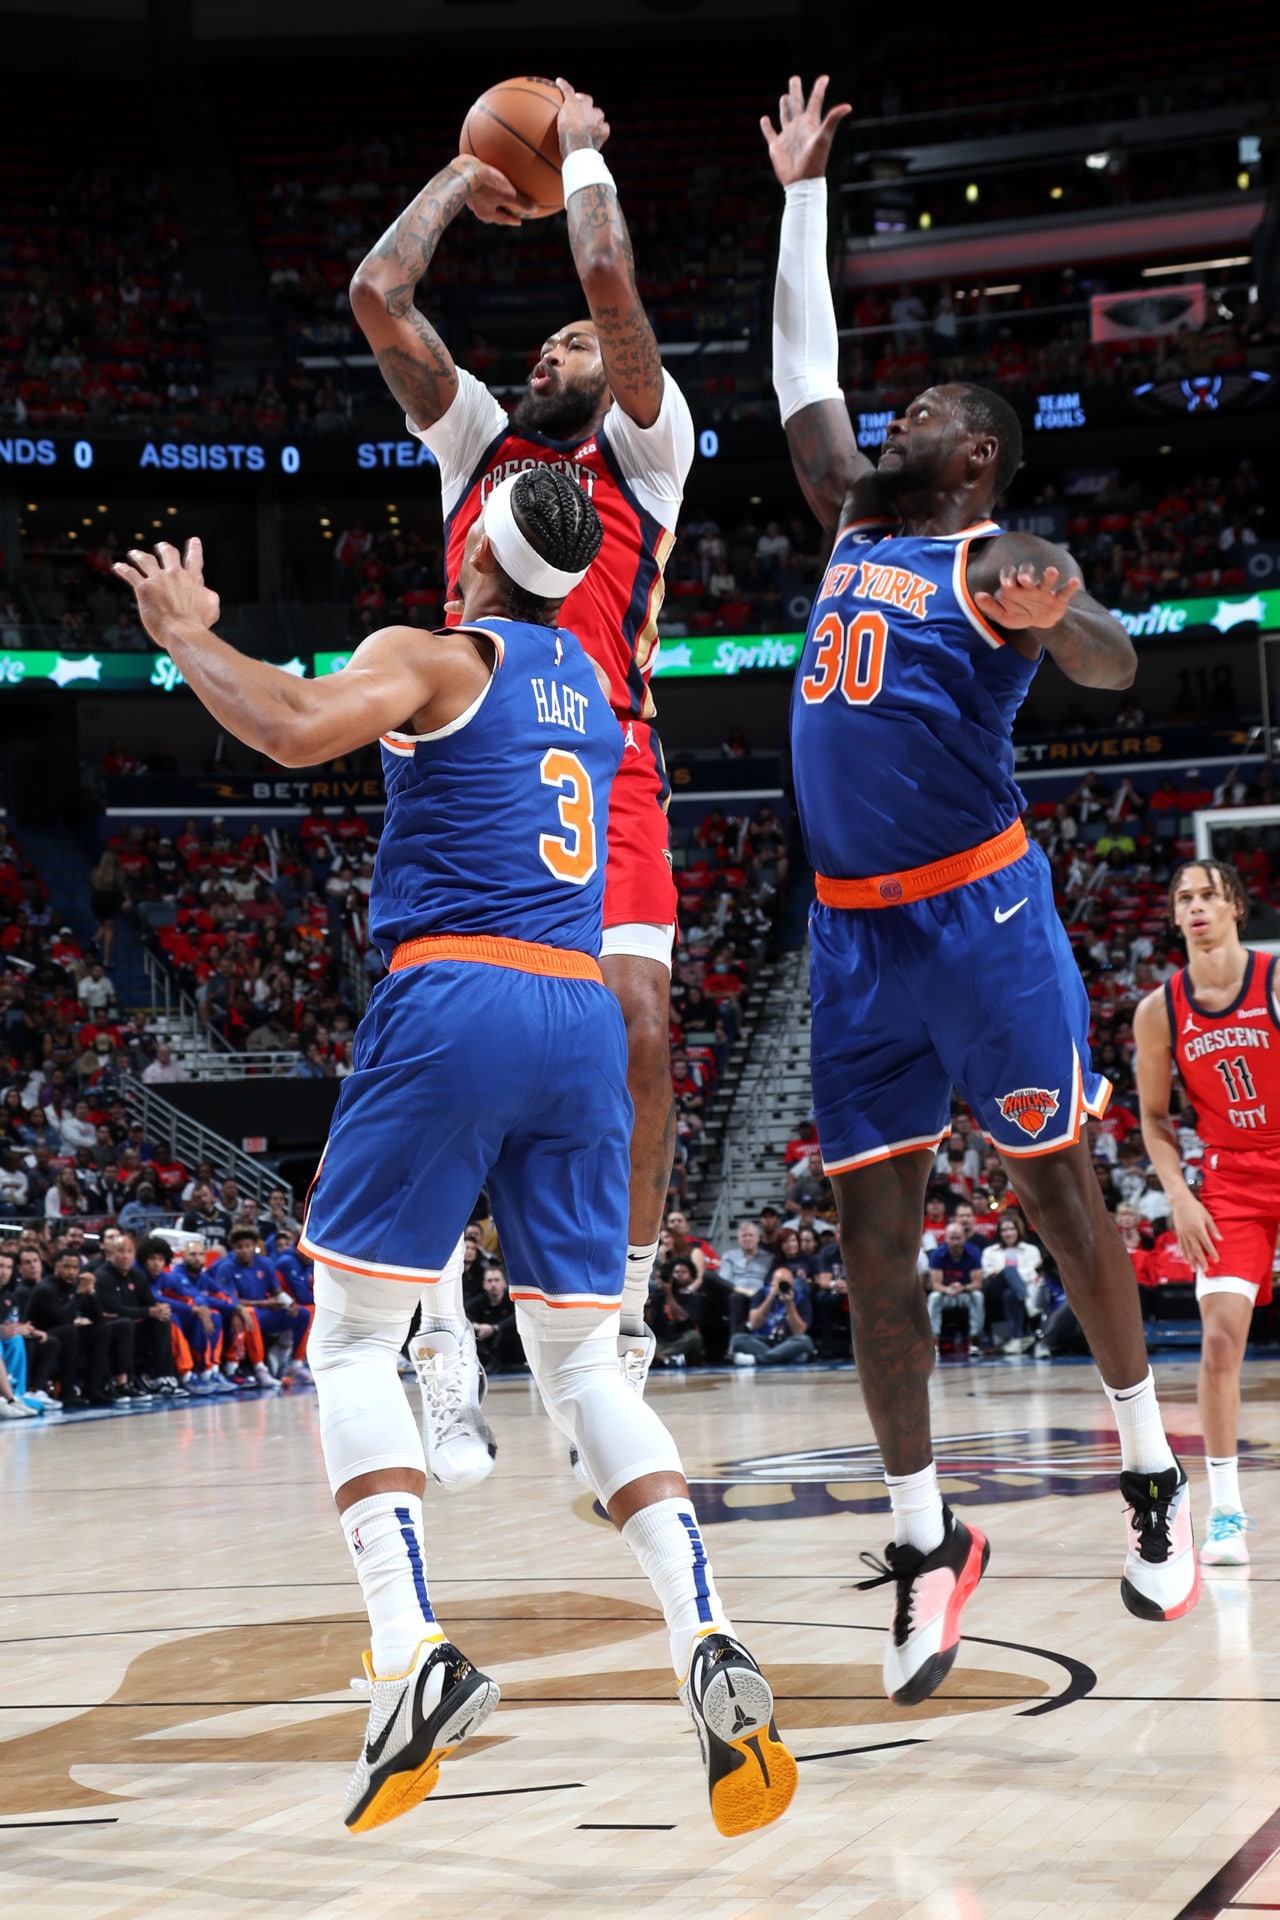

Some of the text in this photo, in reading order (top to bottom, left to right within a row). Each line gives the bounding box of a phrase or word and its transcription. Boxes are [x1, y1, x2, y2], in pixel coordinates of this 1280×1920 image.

[1034, 408, 1086, 431] FOULS
[1037, 392, 1080, 409] TEAM
[74, 441, 93, 469] 0
[139, 442, 266, 471] ASSISTS
[281, 446, 300, 474] 0
[357, 442, 437, 469] STEA
[700, 430, 719, 457] 0
[853, 560, 938, 621] YORK
[713, 637, 797, 675] Sprite
[801, 610, 889, 705] 30
[531, 678, 588, 735] HART
[253, 780, 385, 799] BETRIVE
[539, 748, 597, 885] 3
[1184, 1026, 1270, 1062] CRESCENT
[1214, 1056, 1257, 1102] 11
[1003, 1091, 1057, 1115] KNICKS
[1228, 1104, 1267, 1129] CITY
